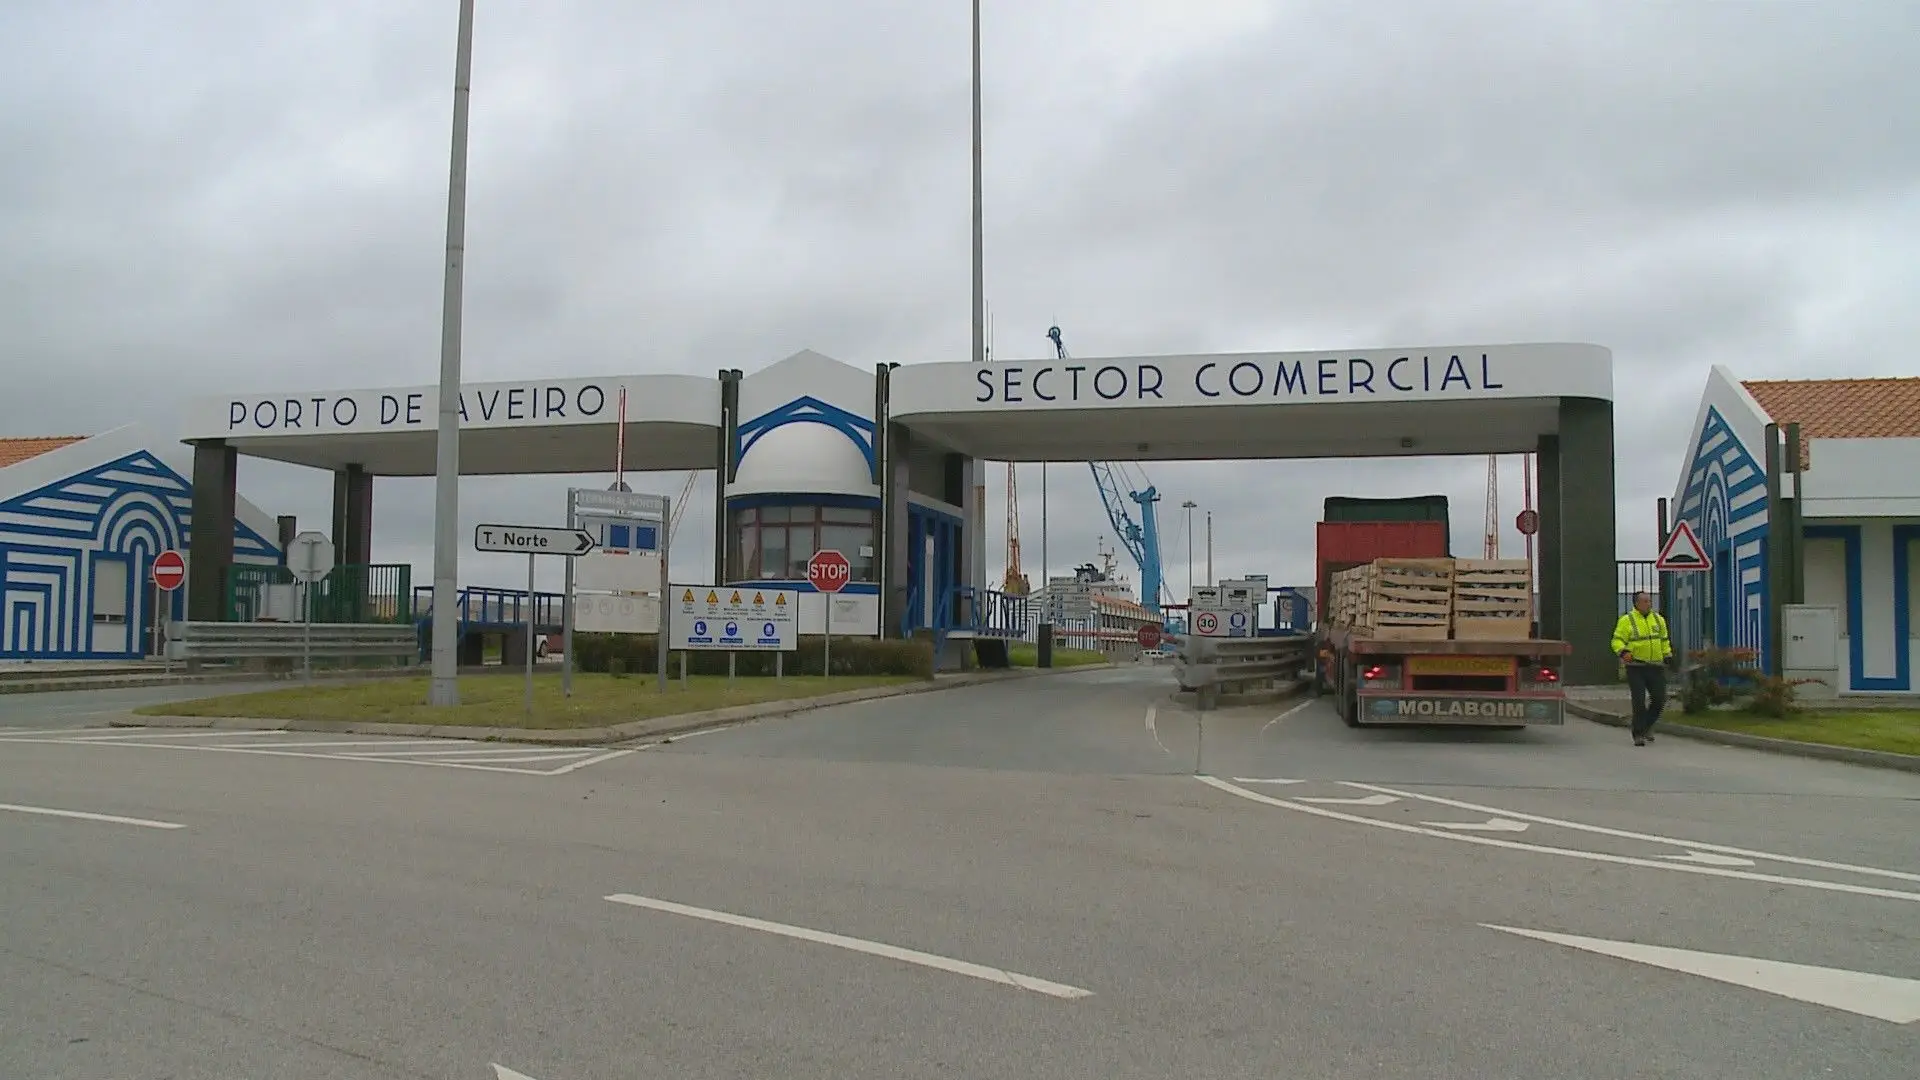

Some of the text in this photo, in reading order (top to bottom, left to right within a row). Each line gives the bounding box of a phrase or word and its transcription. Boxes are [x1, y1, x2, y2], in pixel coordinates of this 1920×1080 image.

[976, 354, 1503, 402] SECTOR COMERCIAL
[230, 397, 357, 429] PORTO
[381, 394, 422, 425] DE
[483, 531, 548, 547] T. Norte
[810, 563, 848, 580] STOP
[1200, 617, 1215, 628] 30
[1139, 631, 1160, 642] STOP
[1398, 700, 1524, 717] MOLABOIM
